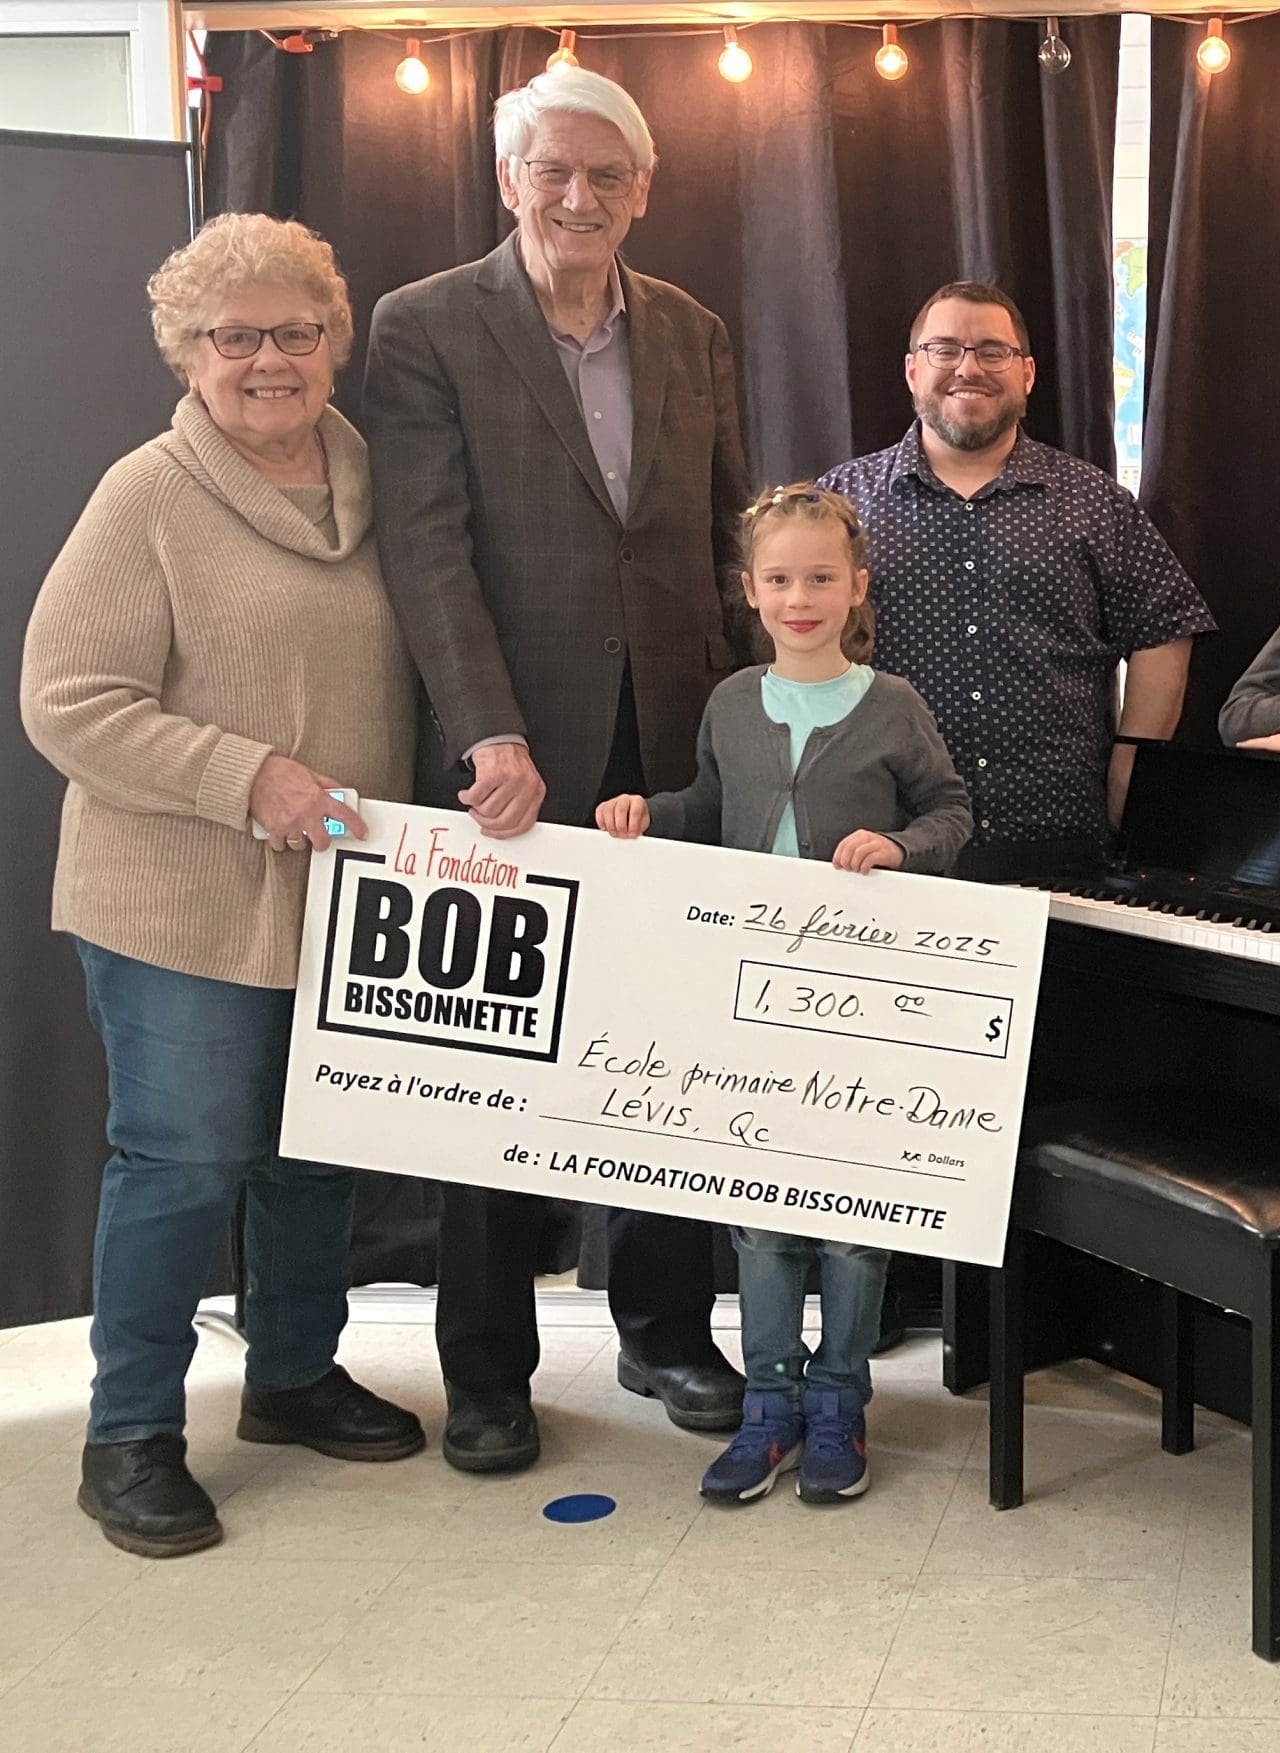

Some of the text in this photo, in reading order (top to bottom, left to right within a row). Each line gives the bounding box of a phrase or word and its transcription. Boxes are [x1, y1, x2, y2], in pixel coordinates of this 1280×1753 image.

[393, 823, 519, 889] La Fondation
[348, 877, 549, 998] BOB
[686, 904, 1000, 956] Date: 26 février 2025
[344, 983, 539, 1037] BISSONNETTE
[985, 1015, 1003, 1042] $
[315, 1064, 384, 1092] Payez
[387, 1074, 402, 1094] à
[406, 1076, 482, 1105] l'ordre
[578, 1031, 671, 1079] École
[681, 1063, 797, 1095] primaire
[728, 1111, 771, 1146] Qc
[927, 1153, 966, 1168] Dollars
[549, 1150, 580, 1174] LA
[583, 1156, 726, 1195] FONDATION
[728, 1178, 779, 1204] BOB
[783, 1187, 948, 1231] BISSONNETTE
